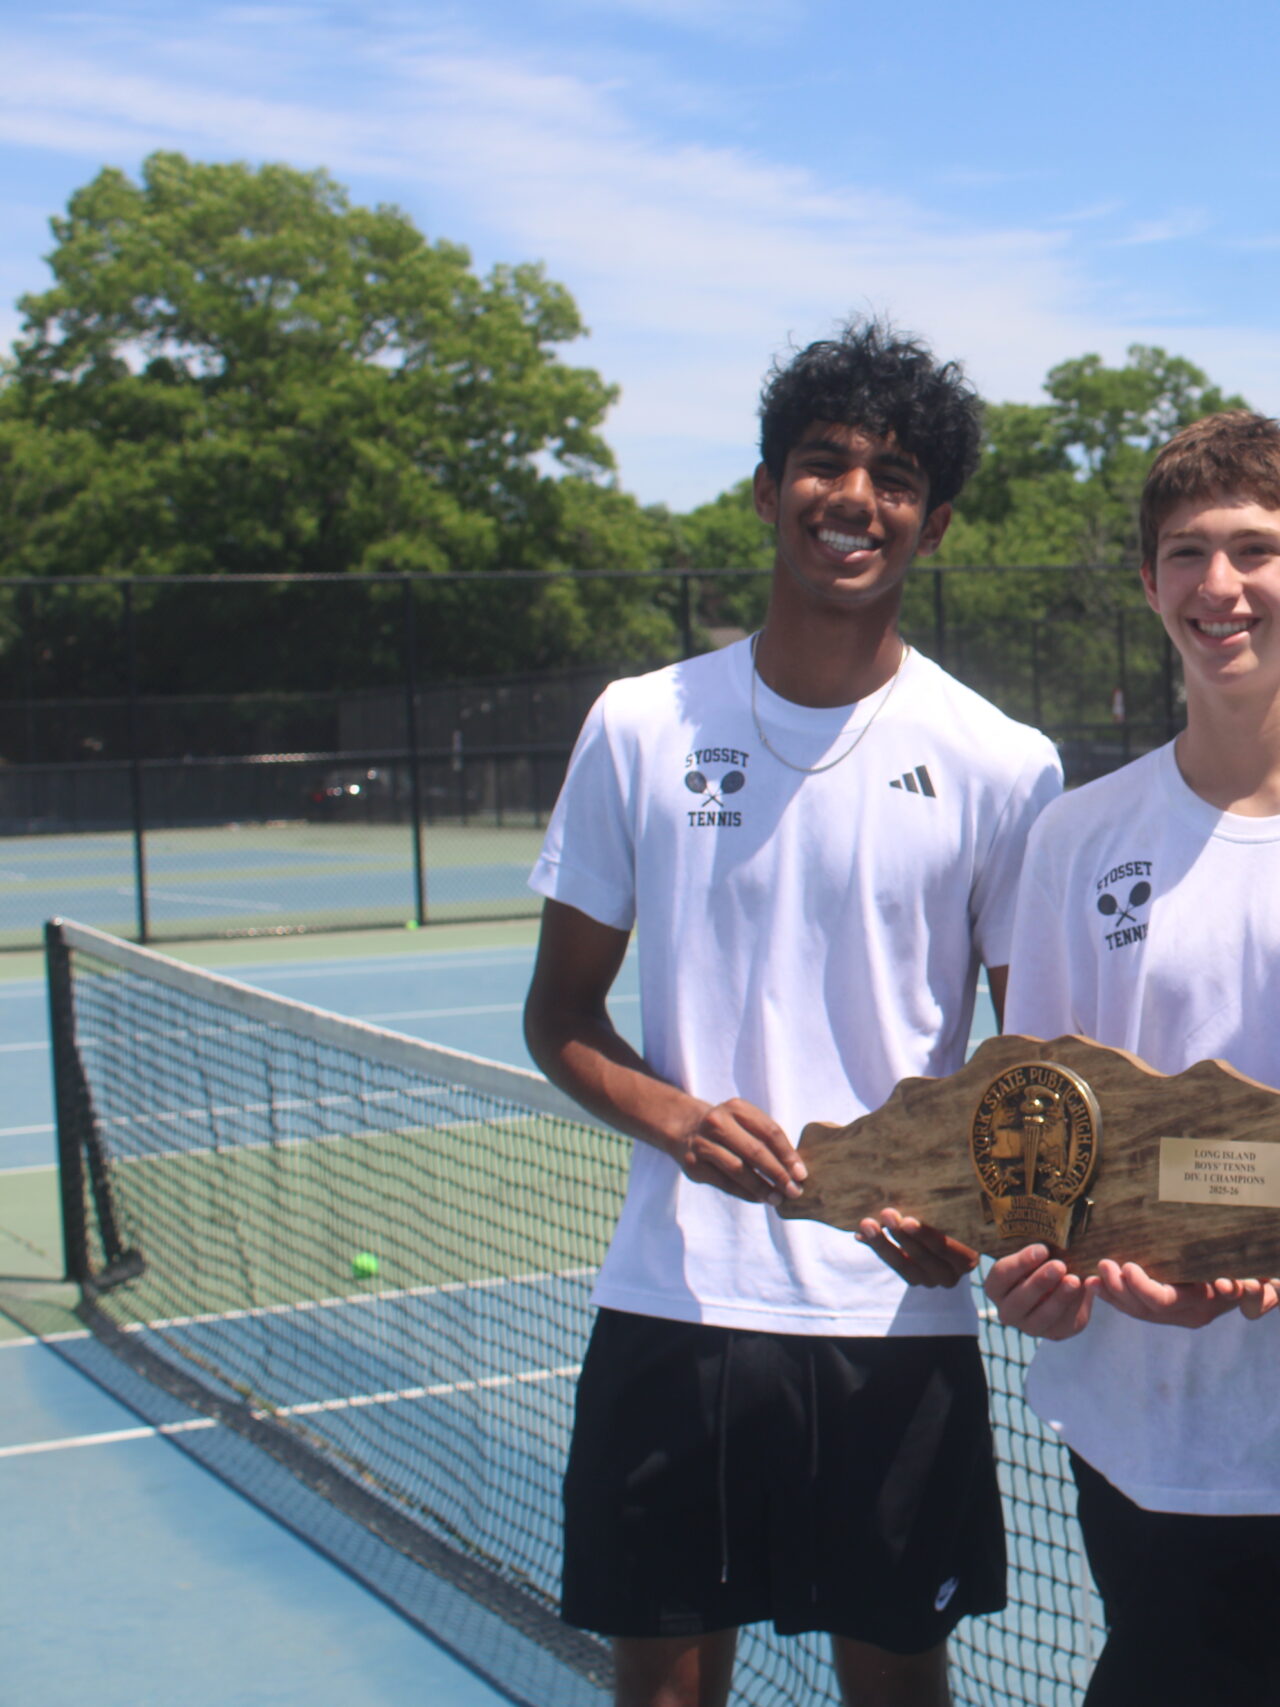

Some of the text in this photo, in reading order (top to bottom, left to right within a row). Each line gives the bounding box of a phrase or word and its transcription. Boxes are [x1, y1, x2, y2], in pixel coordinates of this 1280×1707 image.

[685, 747, 749, 768] SYOSSET
[687, 811, 742, 827] TENNIS
[1105, 923, 1149, 951] TENNI
[974, 1067, 1092, 1198] NEW YORK STATE PUBLIC HIGH SCHOO
[1194, 1149, 1257, 1161] LONG ISLAND
[1223, 1163, 1256, 1172] TENNIS
[1183, 1172, 1201, 1182] DIV.
[1209, 1174, 1266, 1185] CHAMPIONS
[1209, 1185, 1240, 1196] 2025-26
